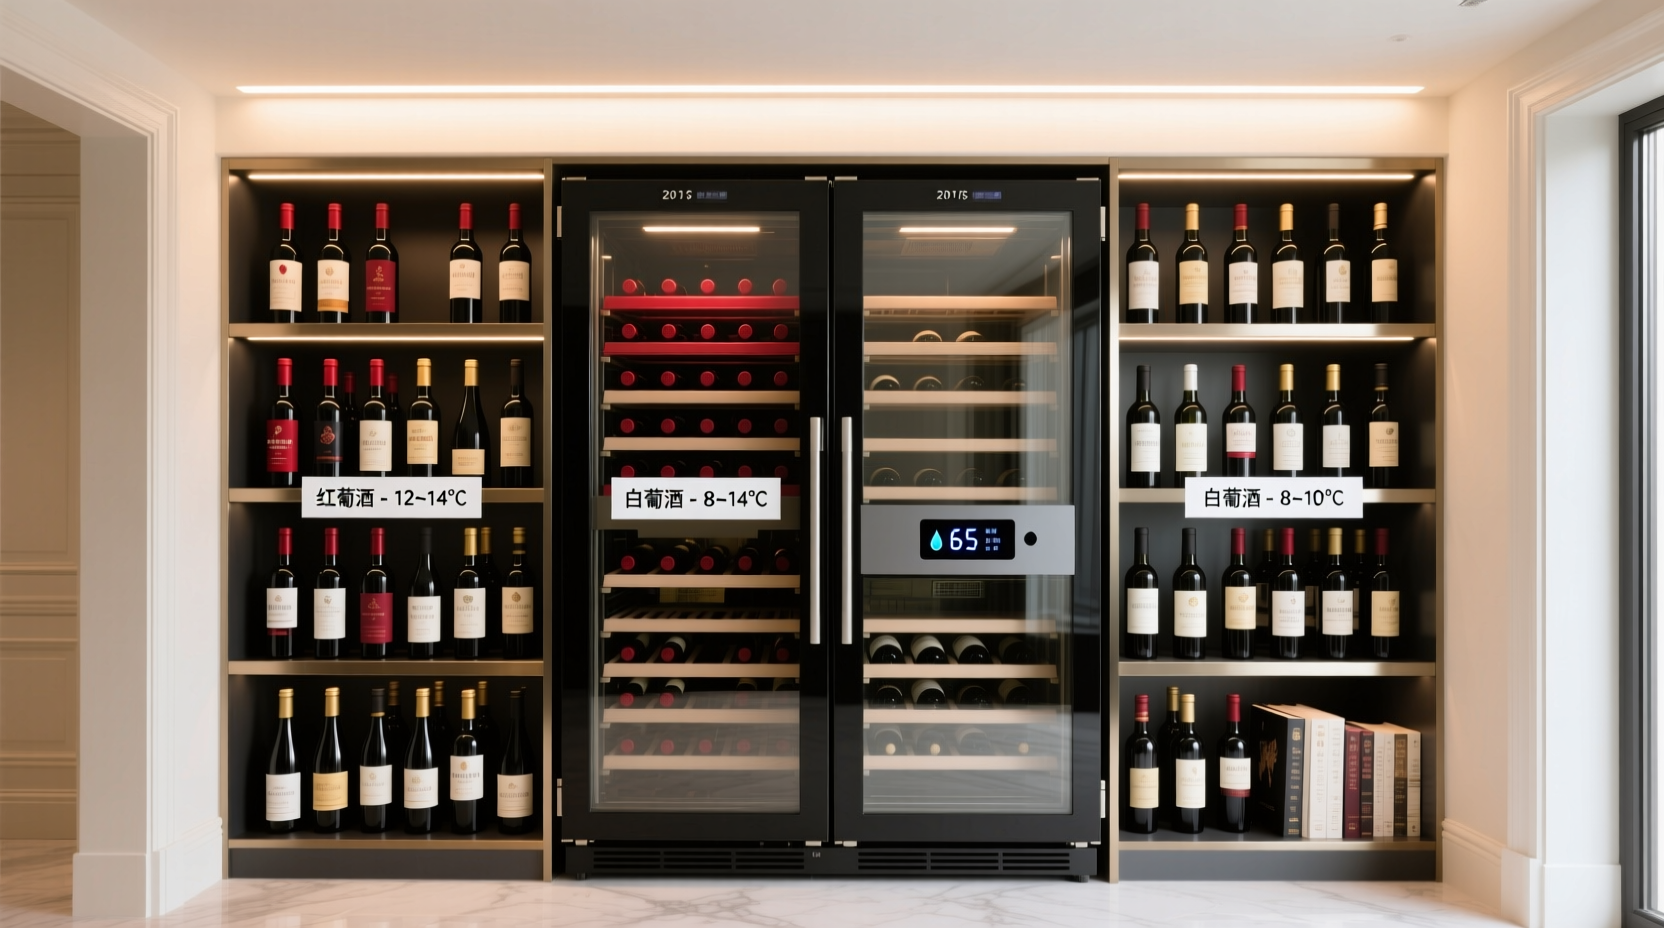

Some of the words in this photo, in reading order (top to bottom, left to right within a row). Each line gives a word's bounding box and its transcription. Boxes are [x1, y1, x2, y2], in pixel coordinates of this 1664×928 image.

[625, 487, 684, 509] 白葡酒
[1204, 487, 1261, 508] 白葡酒
[950, 528, 978, 551] 65
